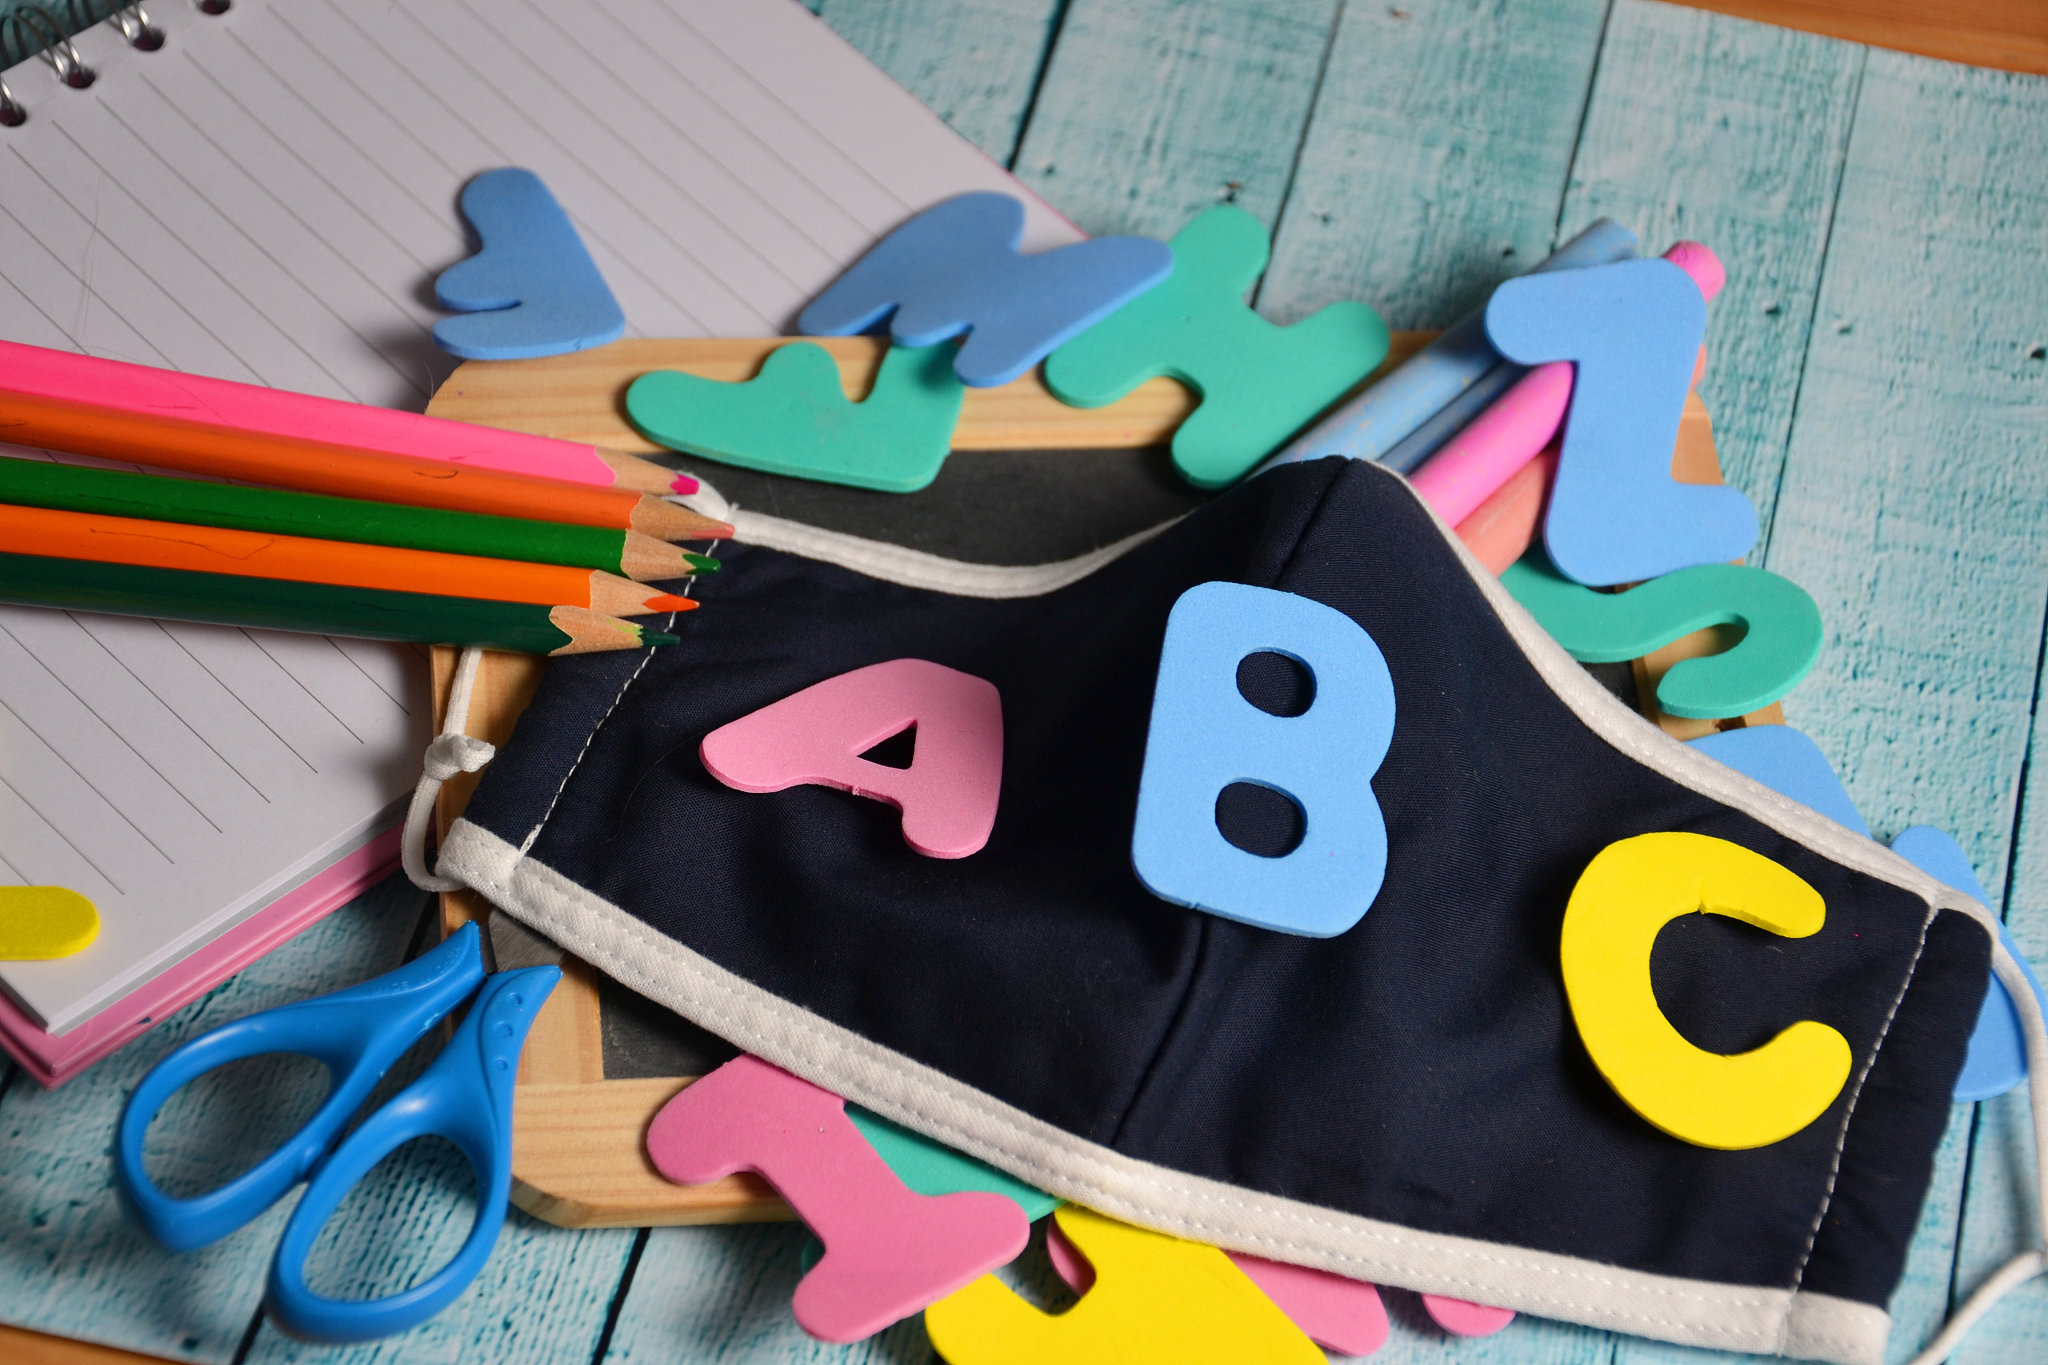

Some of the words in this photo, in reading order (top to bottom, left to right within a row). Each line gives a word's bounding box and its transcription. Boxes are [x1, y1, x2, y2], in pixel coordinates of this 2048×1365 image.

[699, 657, 1004, 860] A
[1131, 580, 1397, 939] B
[1560, 831, 1853, 1151] C
